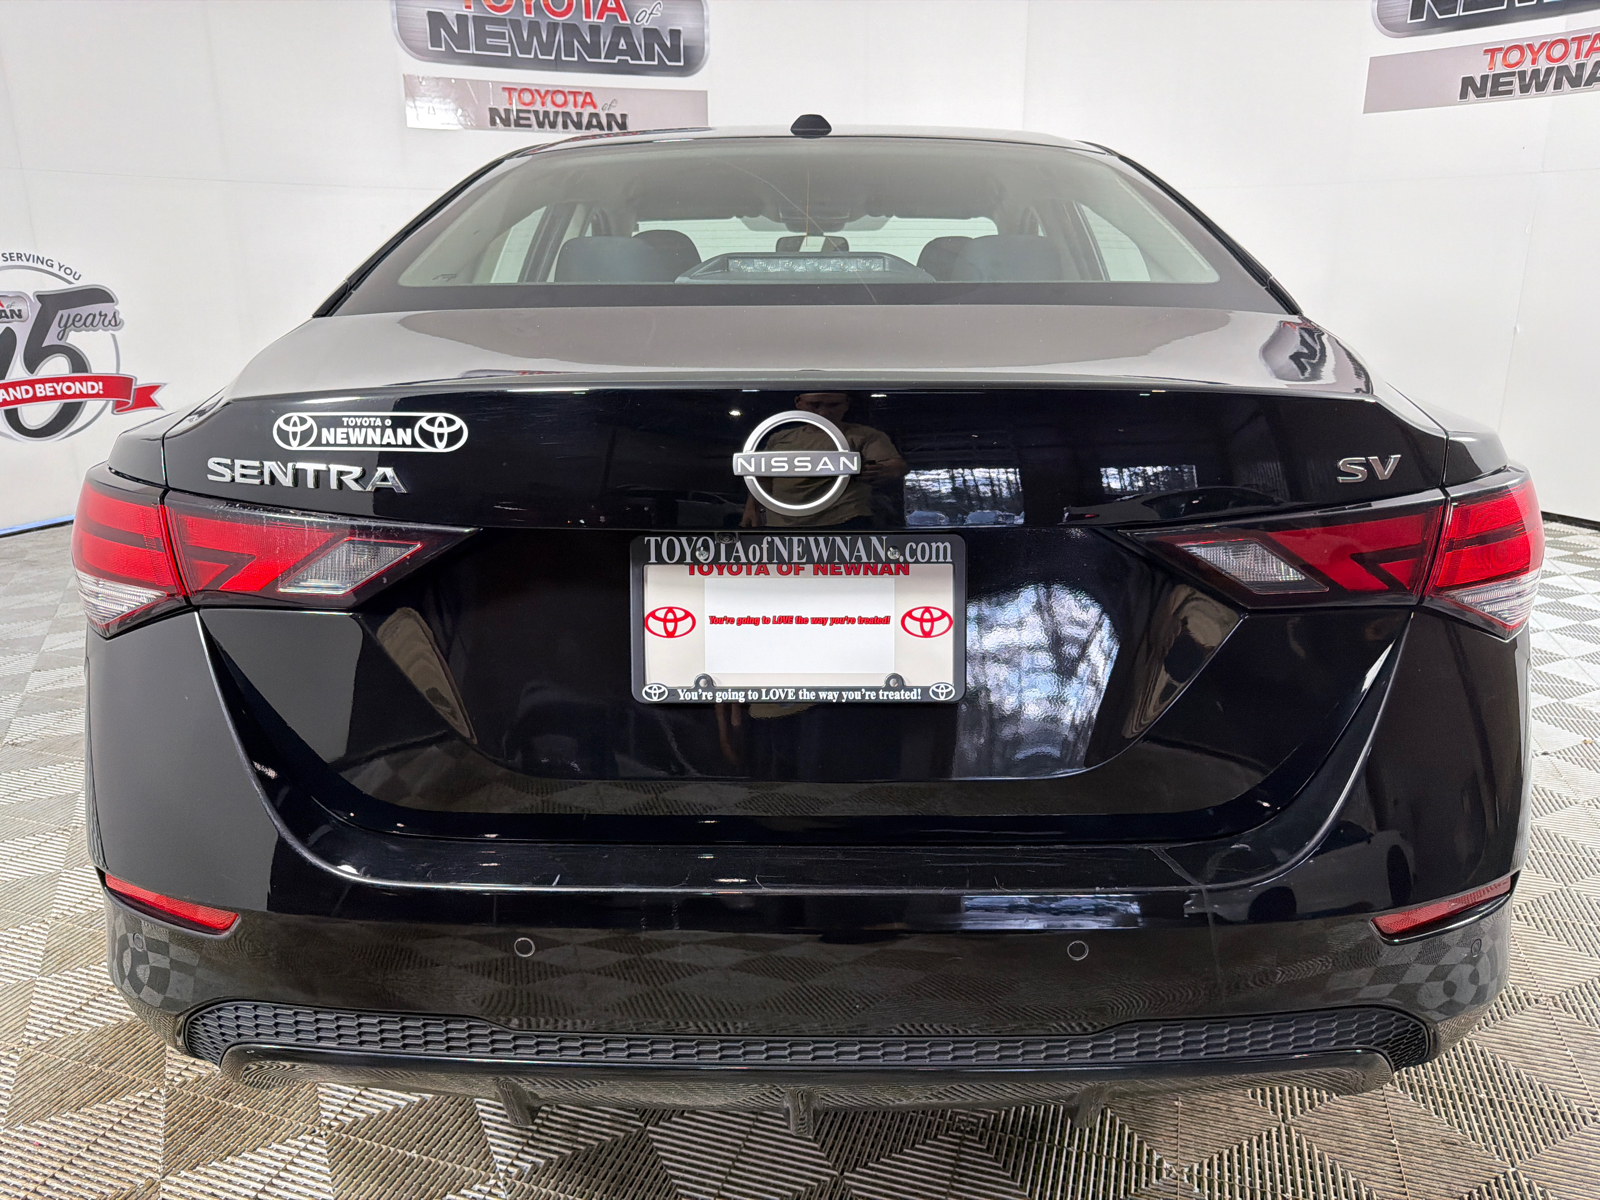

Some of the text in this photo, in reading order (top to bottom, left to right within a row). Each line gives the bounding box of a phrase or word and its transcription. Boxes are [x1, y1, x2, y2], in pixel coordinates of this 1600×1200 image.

[463, 0, 663, 25] OTA of
[427, 10, 684, 66] NEWNAN
[500, 86, 618, 111] TOYOTA of
[488, 107, 628, 132] NEWNAN
[1, 252, 82, 281] SERVING YOU
[57, 310, 121, 341] years
[0, 381, 103, 402] AND BEYOND!
[342, 417, 382, 426] TOYOTA
[321, 427, 412, 445] NEWNAN
[207, 457, 410, 494] SENTRA
[737, 456, 858, 472] NISSAN
[1336, 454, 1401, 483] SV
[688, 563, 910, 576] TOYOTA OF NEWNAN
[736, 616, 760, 626] going
[762, 616, 771, 625] to
[772, 616, 794, 624] LOVE
[795, 616, 809, 625] the
[810, 617, 828, 626] way
[857, 616, 891, 625] treated!
[677, 689, 922, 703] You're going to LOVE the way you're treated!
